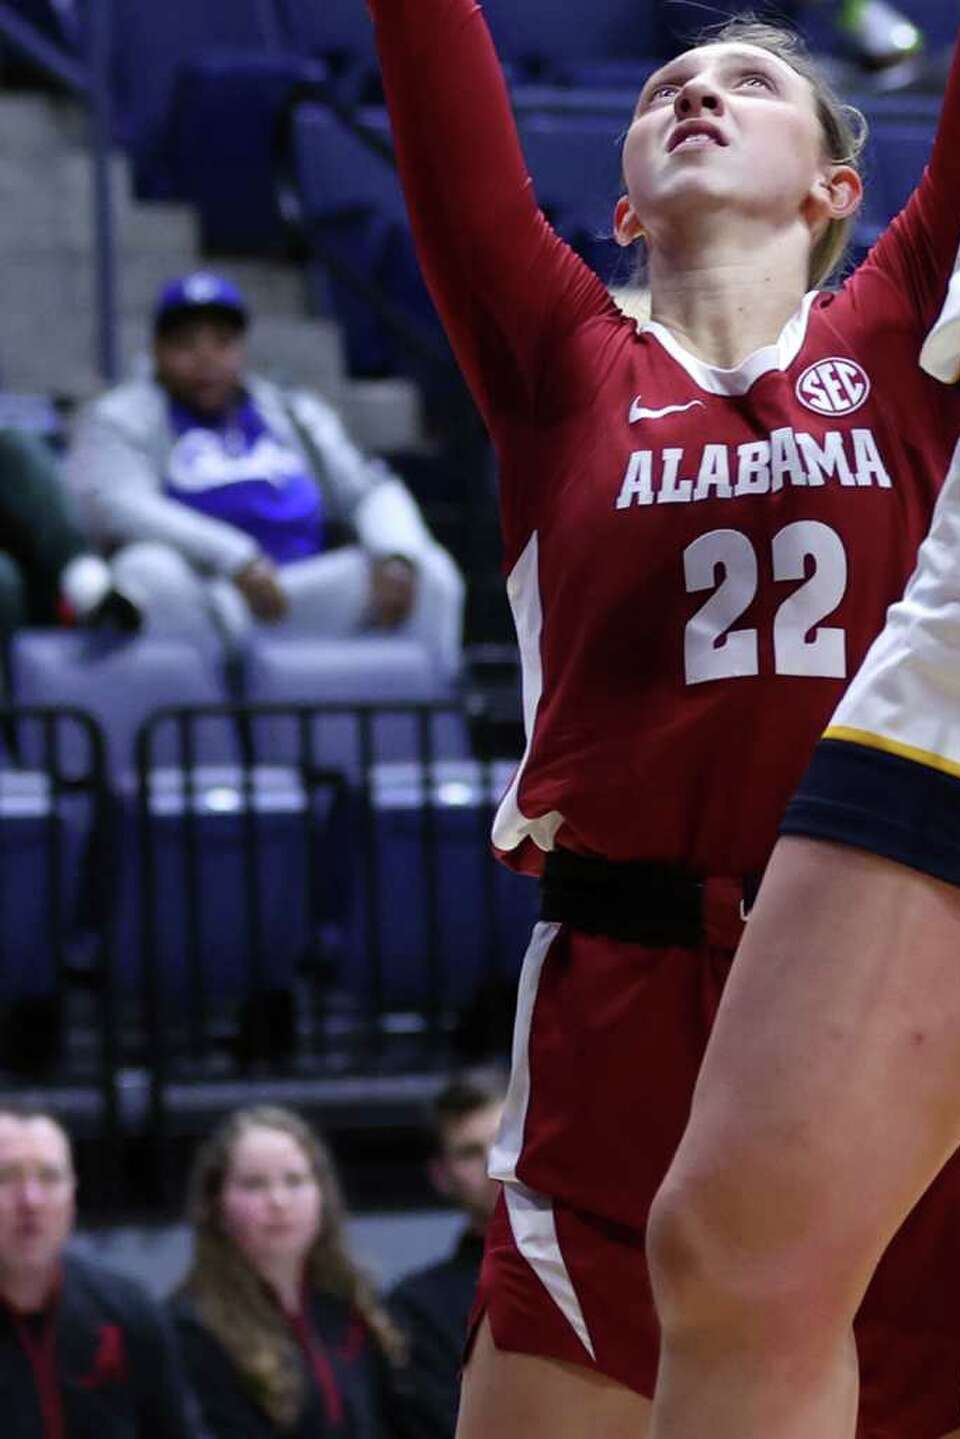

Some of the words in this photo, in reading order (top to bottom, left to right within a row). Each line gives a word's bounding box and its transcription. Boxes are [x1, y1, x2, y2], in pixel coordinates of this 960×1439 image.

[800, 360, 867, 413] SEC
[616, 426, 893, 510] ALABAMA
[683, 520, 848, 686] 22
